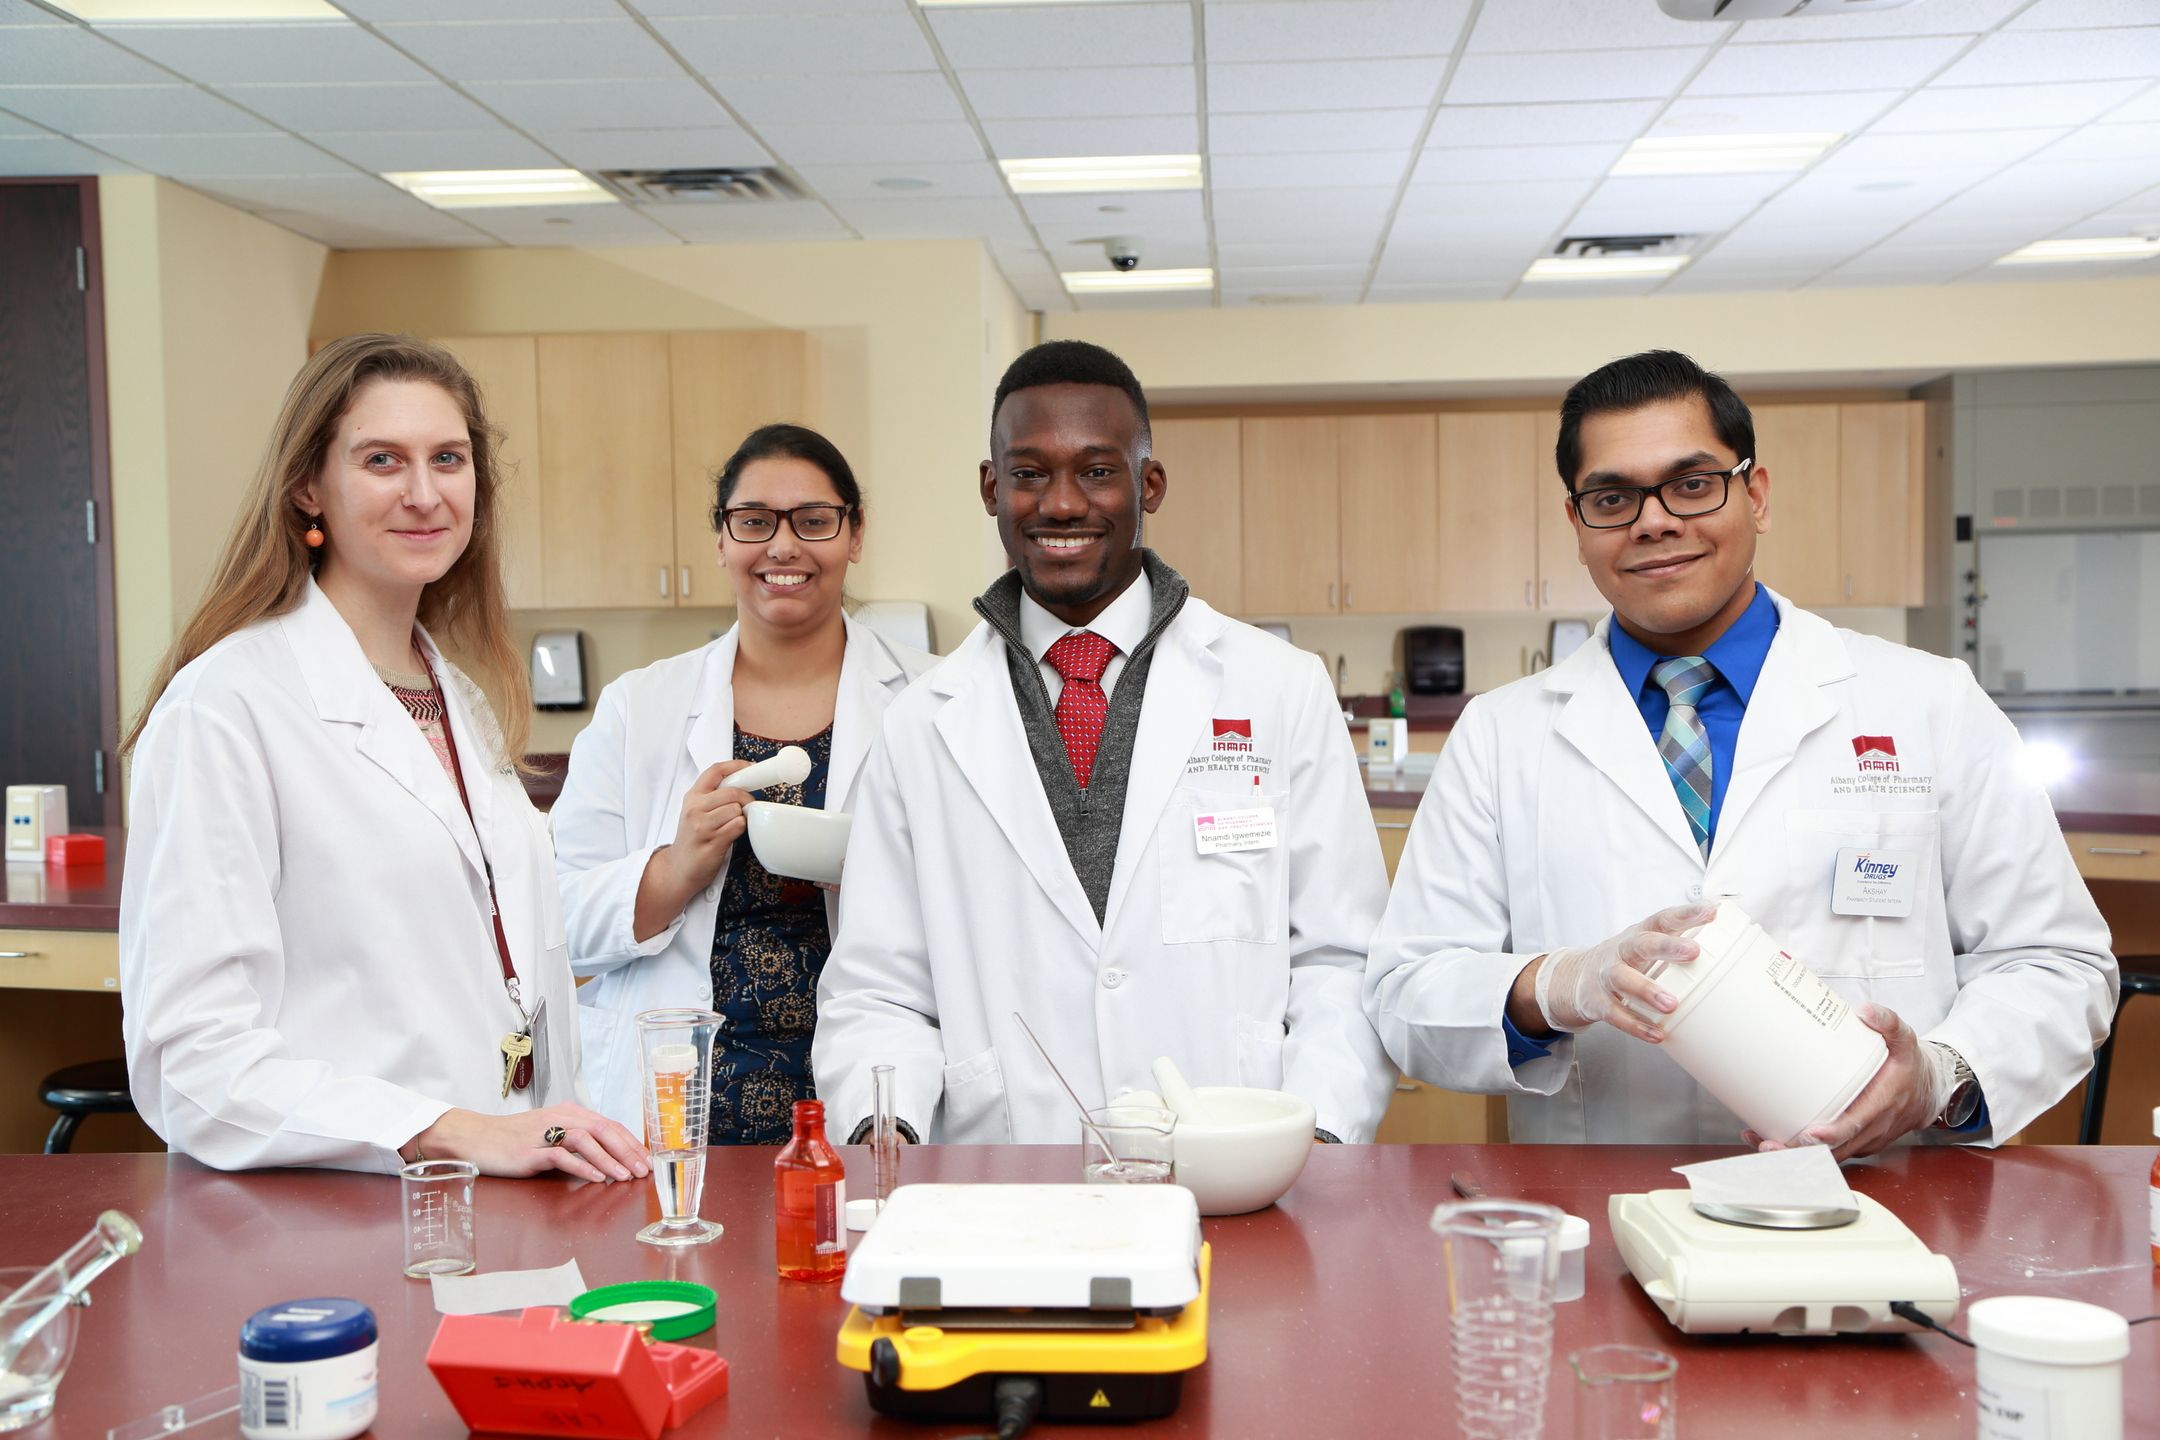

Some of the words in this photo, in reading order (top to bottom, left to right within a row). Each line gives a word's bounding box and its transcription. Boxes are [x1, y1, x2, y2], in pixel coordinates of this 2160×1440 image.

[1211, 754, 1235, 763] College
[1237, 754, 1243, 762] of
[1188, 765, 1204, 774] AND
[1208, 764, 1239, 772] HEALTH
[1830, 776, 1855, 786] Albany
[1882, 774, 1890, 783] of
[1894, 775, 1932, 785] Pharmacy
[1833, 786, 1851, 794] AND
[1855, 785, 1886, 793] HEALTH
[1889, 786, 1932, 794] SCIENCES
[1202, 833, 1231, 842] Nnamdi
[1232, 831, 1271, 840] Igwemezie
[1854, 858, 1899, 878] Kinney
